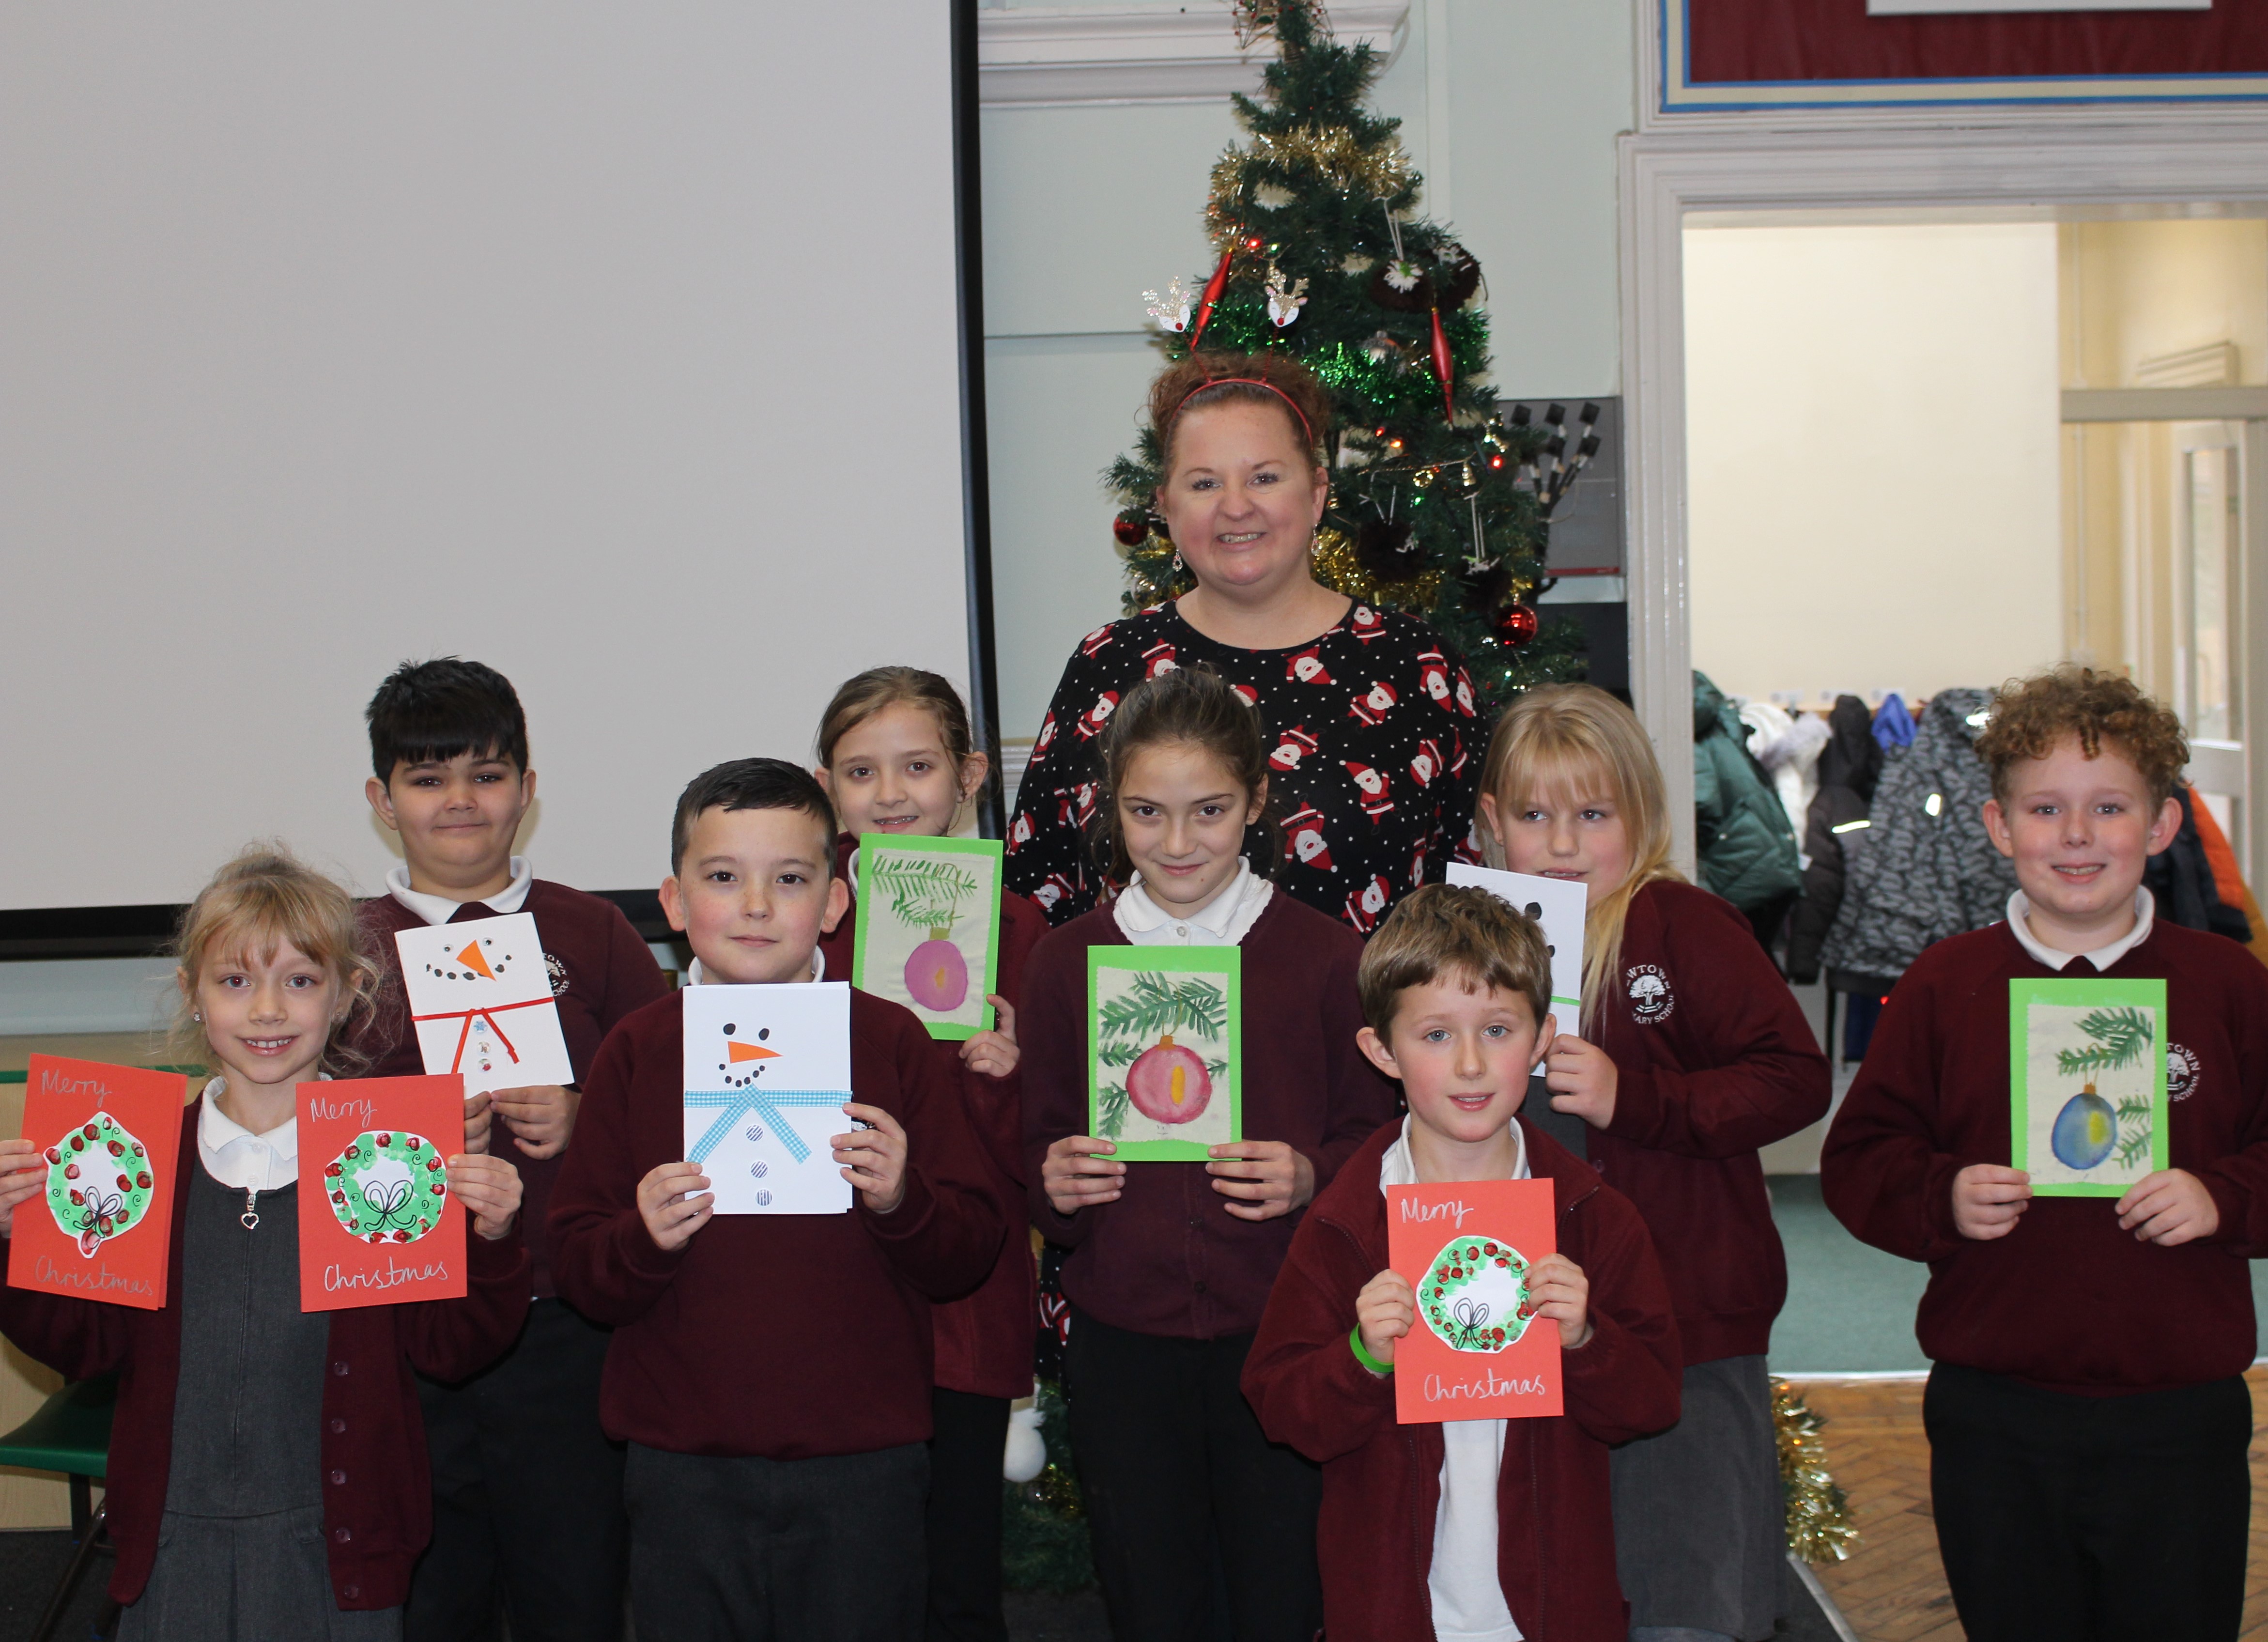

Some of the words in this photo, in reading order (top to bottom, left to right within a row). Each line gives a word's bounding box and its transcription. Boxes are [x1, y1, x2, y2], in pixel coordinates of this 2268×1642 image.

[1626, 964, 1670, 989] WTOWN
[42, 1069, 112, 1108] Merry
[310, 1097, 377, 1129] Merry
[1401, 1197, 1474, 1229] Merry
[34, 1255, 153, 1296] Christmas
[324, 1256, 448, 1292] Christmas
[1424, 1368, 1546, 1402] Christmas
